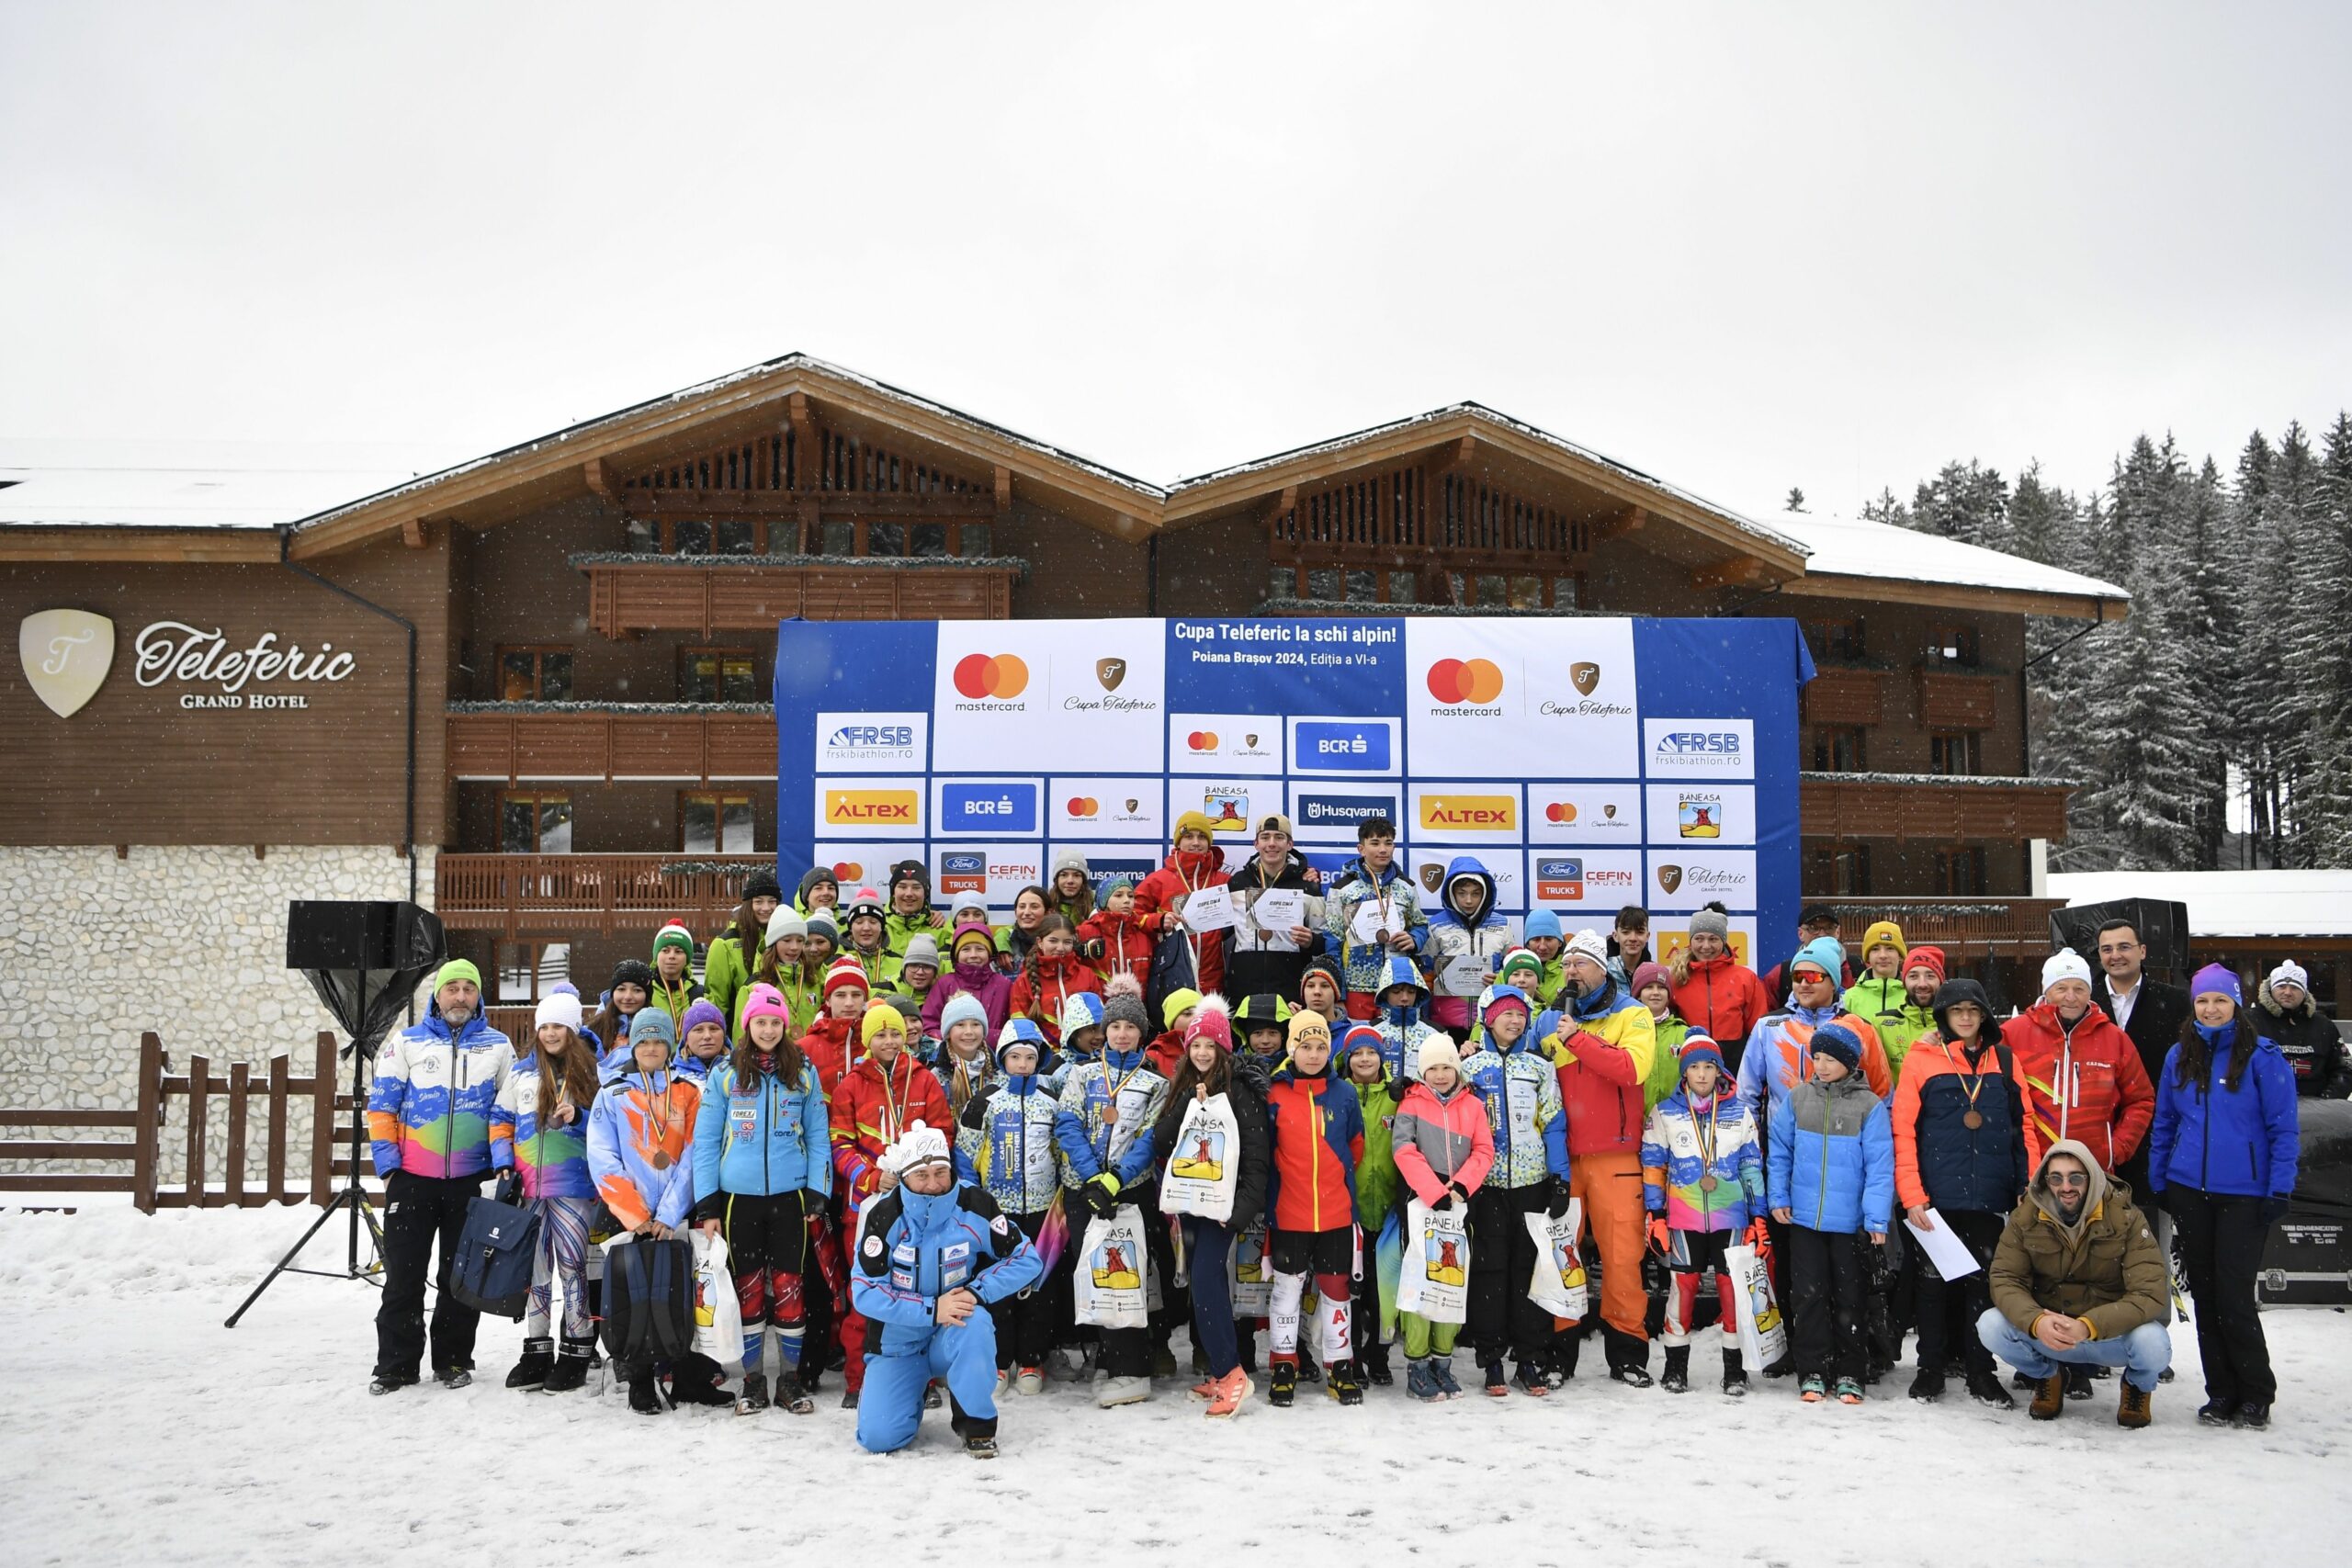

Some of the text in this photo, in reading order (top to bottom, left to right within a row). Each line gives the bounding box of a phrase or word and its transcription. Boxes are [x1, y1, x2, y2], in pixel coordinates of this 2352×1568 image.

[1175, 623, 1396, 646] Cupa Teleferic la schi alpin!
[135, 620, 356, 694] Teleferic
[1193, 651, 1230, 662] Poiana
[1275, 653, 1306, 666] 2024,
[1345, 657, 1352, 665] a
[1355, 654, 1377, 665] VI-a
[180, 694, 308, 709] GRAND HOTEL
[956, 702, 1025, 712] mastercard
[1064, 694, 1157, 713] Cupa Teleferic
[1540, 700, 1632, 717] Cupa Teleferic
[1430, 706, 1501, 716] mastercard
[849, 727, 912, 746] FRSB
[1676, 733, 1739, 753] FRSB
[1318, 739, 1349, 753] BCR
[827, 750, 913, 759] frskibiathlon.ro
[1656, 755, 1741, 766] frskibiathlon.ro
[965, 800, 995, 814] BCR
[1322, 805, 1386, 818] Husqvarna
[952, 856, 974, 868] Ford
[1549, 863, 1570, 875] Ford
[989, 865, 1035, 874] CEFIN
[1586, 871, 1633, 880] CEFIN
[1688, 866, 1746, 886] Teleferic
[1320, 871, 1344, 884] BC
[949, 881, 978, 889] TRUCKS
[1294, 1026, 1329, 1043] VANS
